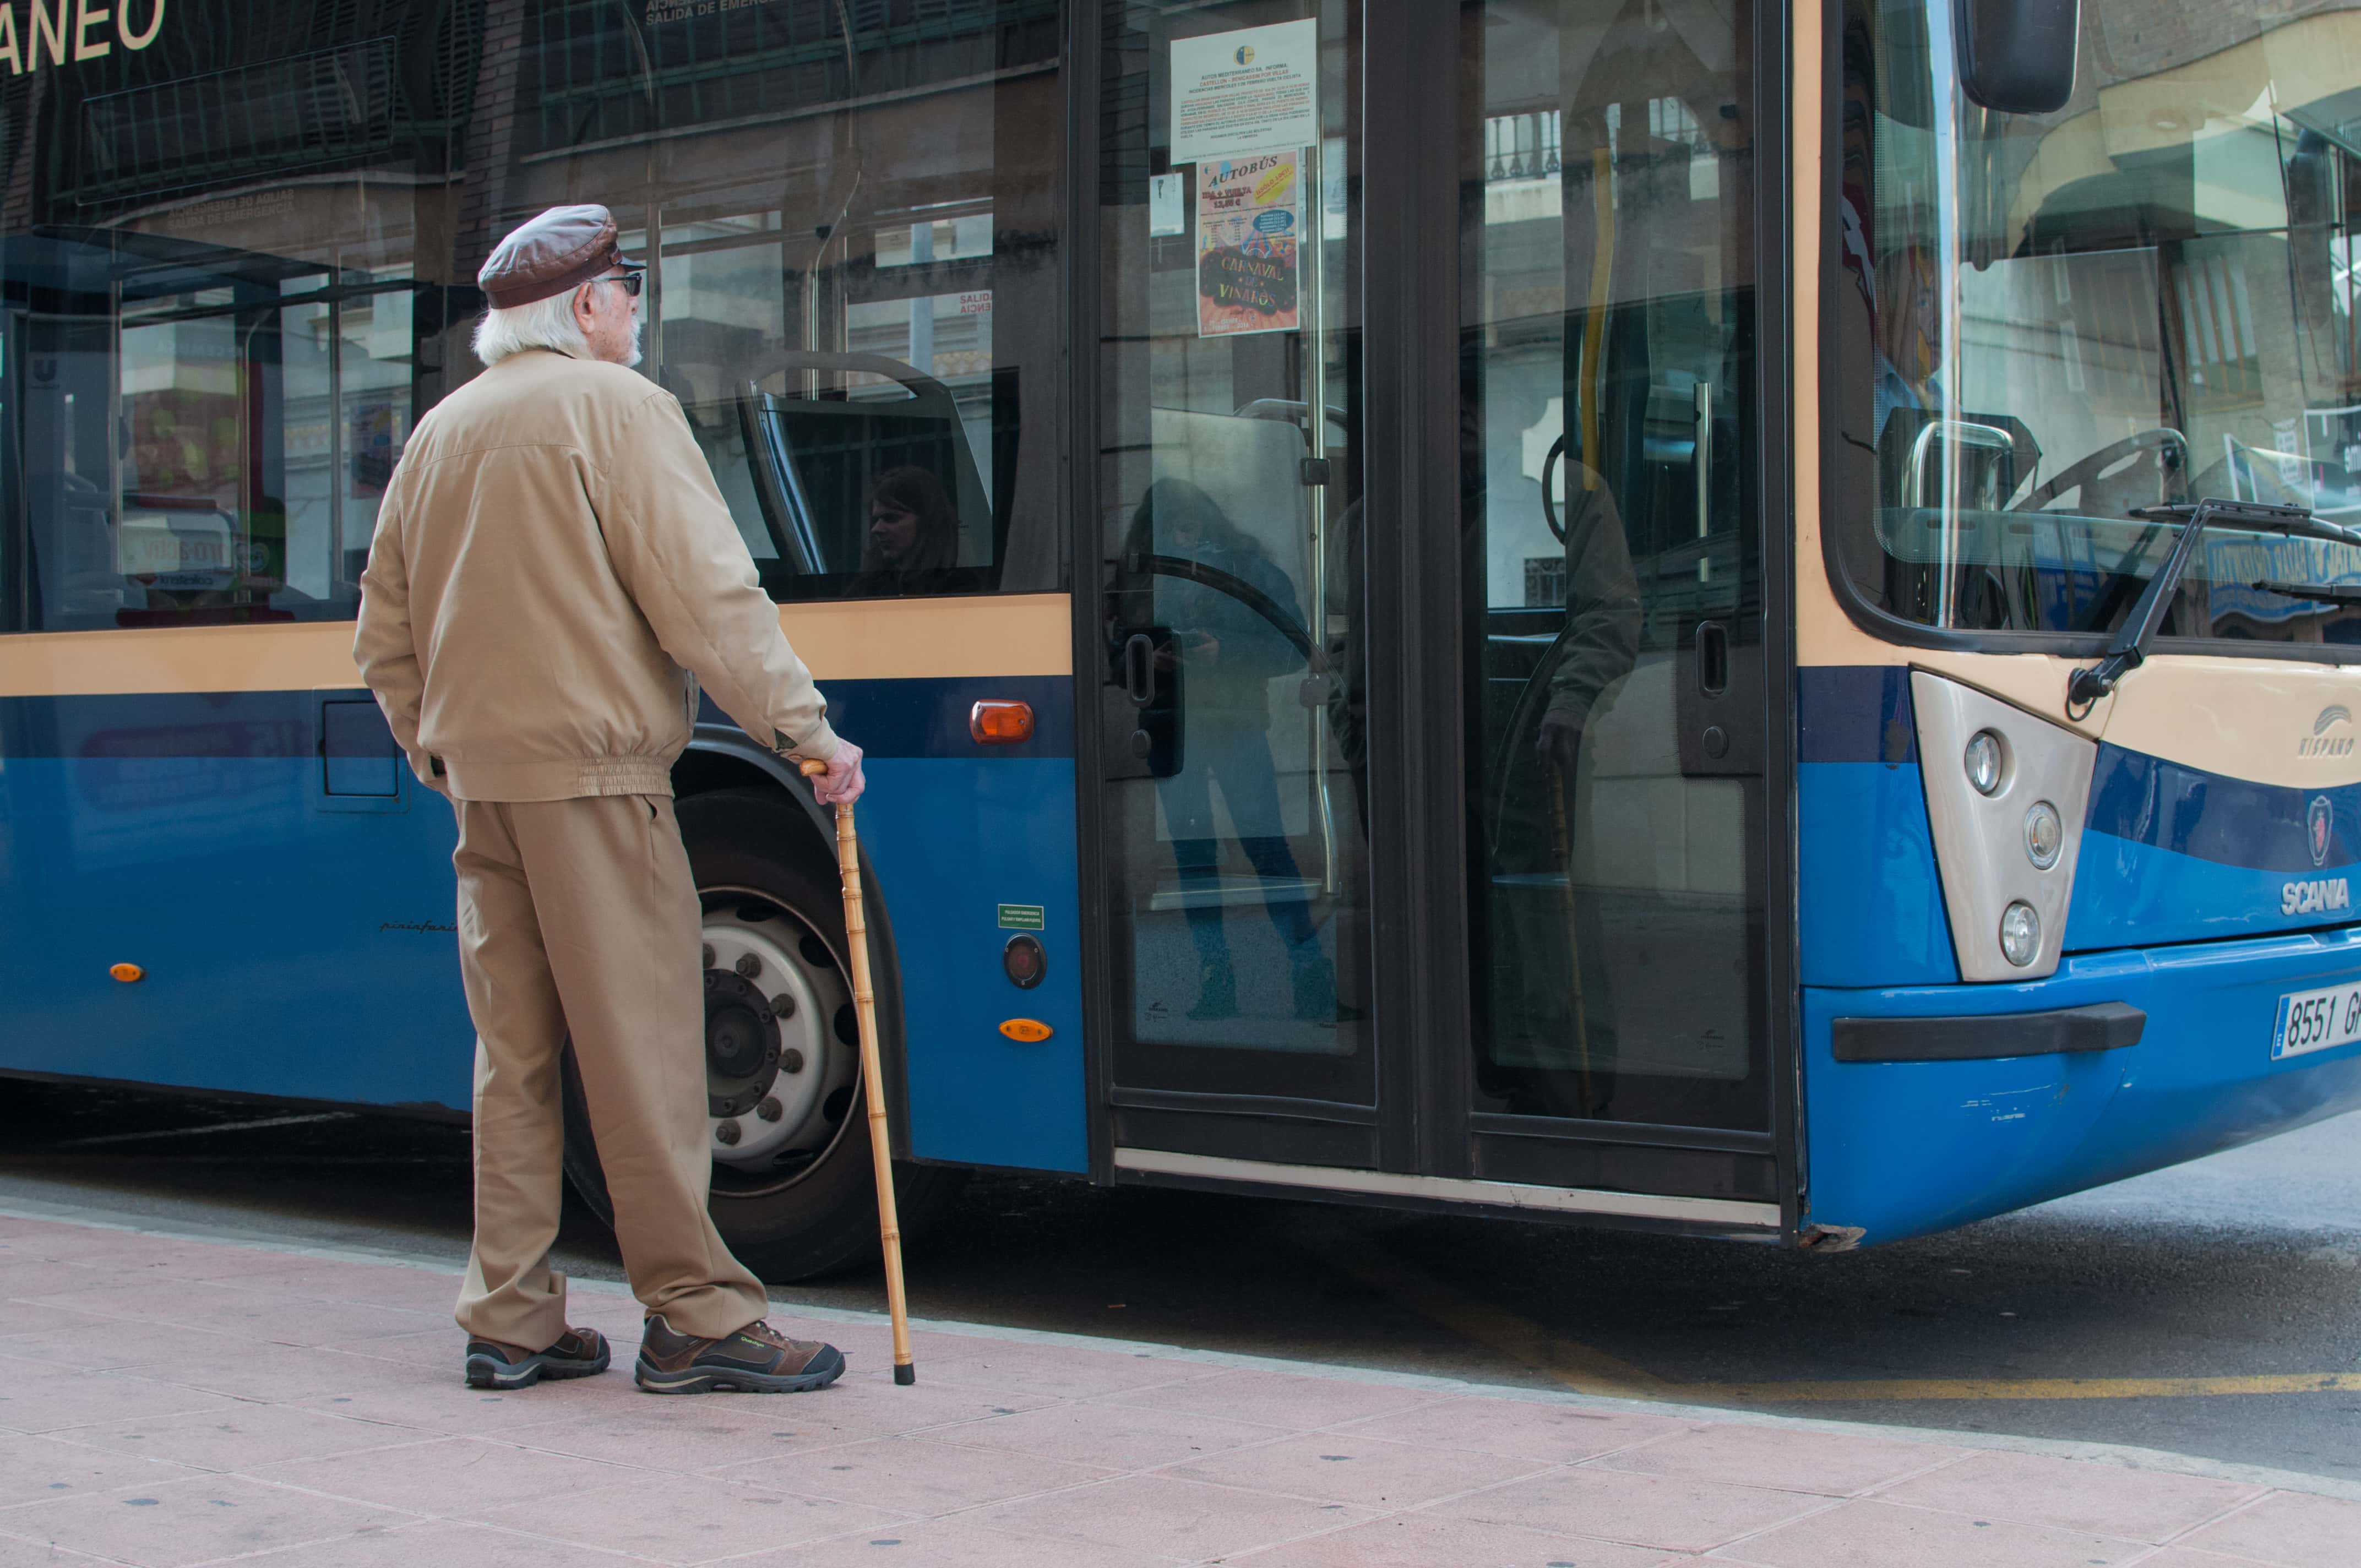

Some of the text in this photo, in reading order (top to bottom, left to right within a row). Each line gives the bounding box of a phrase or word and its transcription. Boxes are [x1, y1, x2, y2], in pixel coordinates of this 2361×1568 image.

[646, 8, 693, 26] SALIDA
[698, 3, 715, 16] DE
[1208, 155, 1277, 187] AUTOBÚS
[1221, 257, 1283, 281] CARNAVAL
[2298, 738, 2355, 756] HISPANO
[2281, 878, 2349, 916] SCANIA
[379, 920, 458, 934] pininfari
[2288, 995, 2336, 1047] 8551
[2344, 991, 2361, 1035] G
